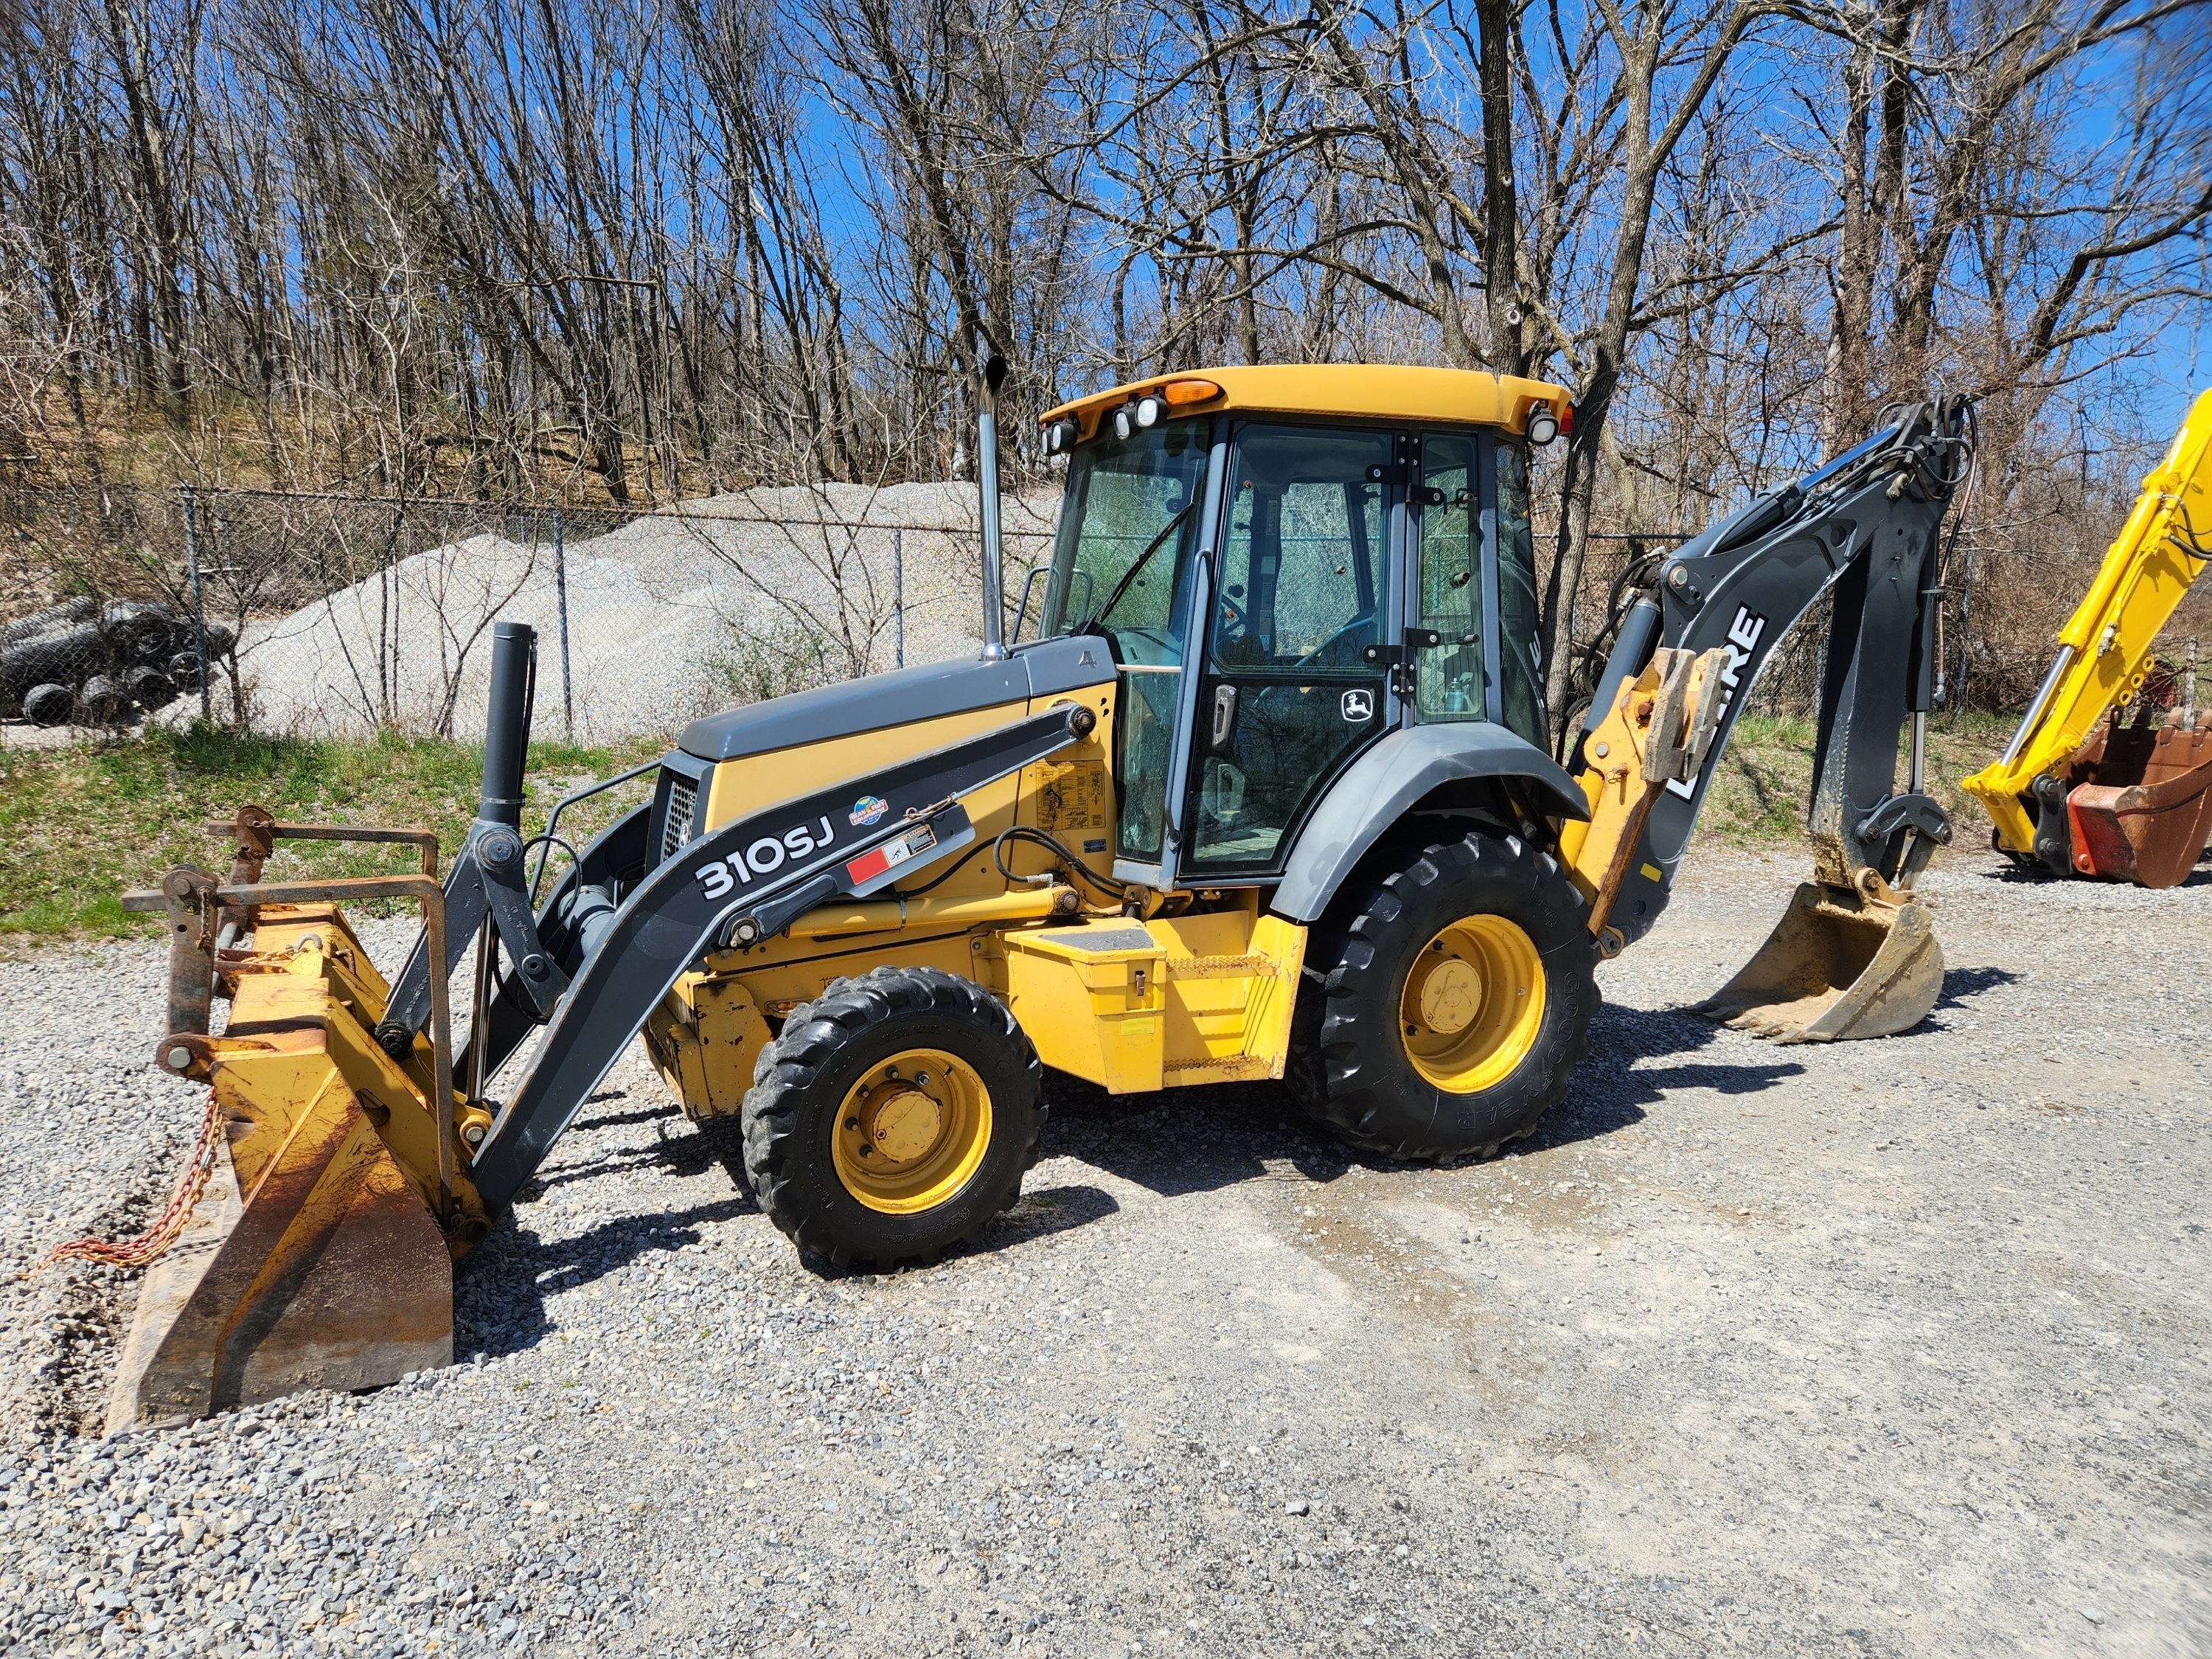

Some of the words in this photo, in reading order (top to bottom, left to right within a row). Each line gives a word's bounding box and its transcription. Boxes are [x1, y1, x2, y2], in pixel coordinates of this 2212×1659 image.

[850, 809, 866, 819] DEAN
[871, 801, 886, 811] FREY
[853, 807, 886, 824] EQUIPMENT
[695, 815, 835, 900] 310SJ
[1457, 971, 1579, 1130] GOODYEAR
